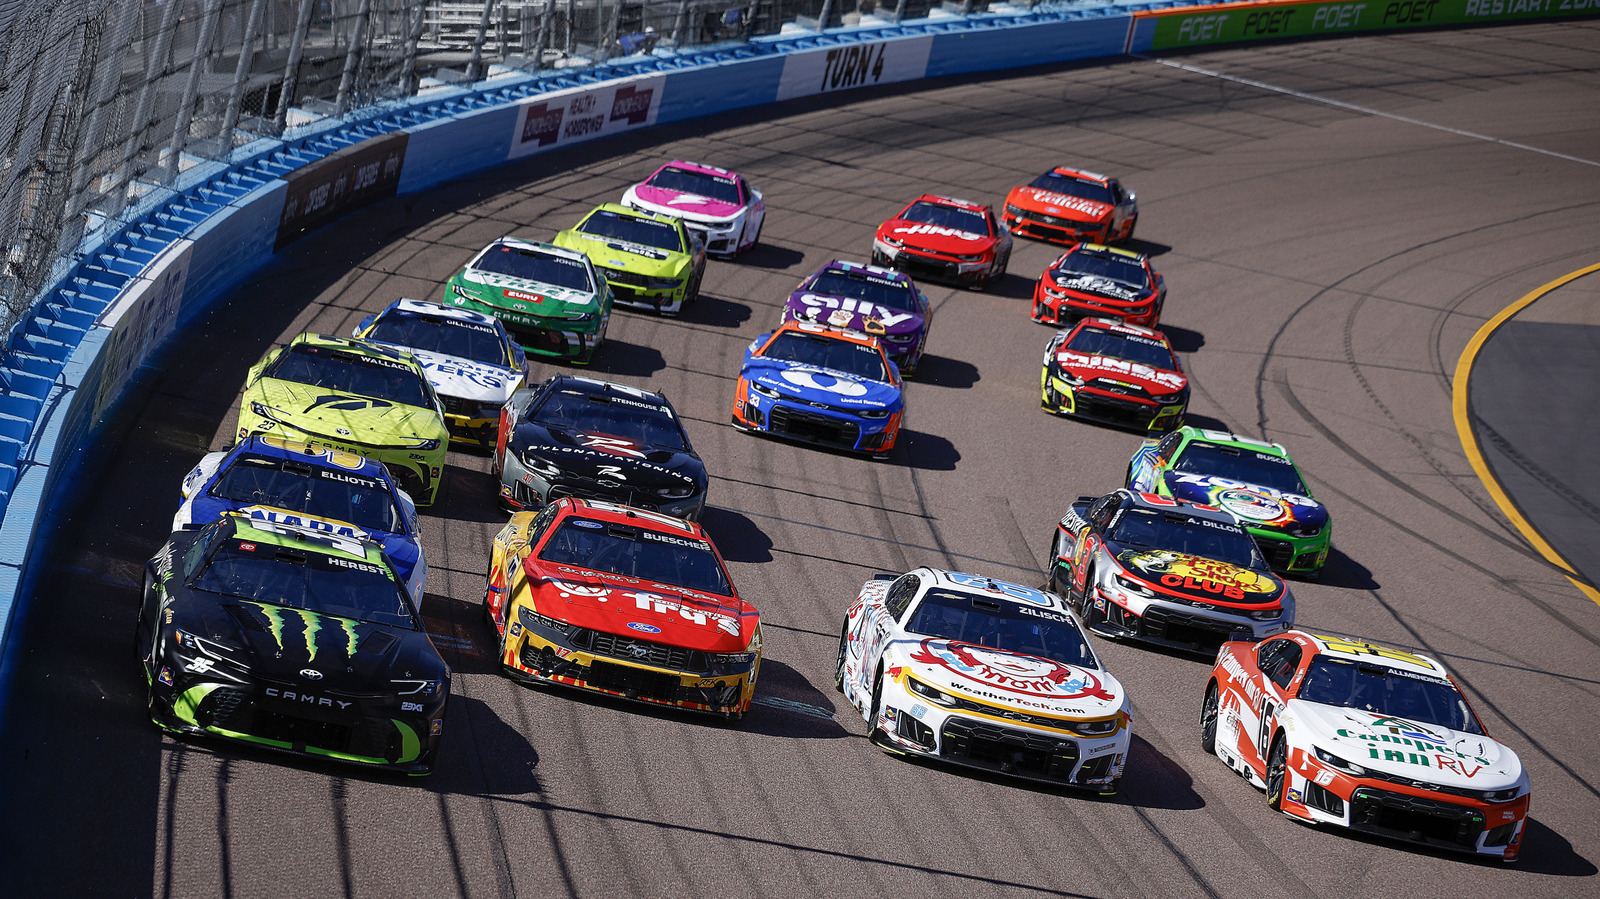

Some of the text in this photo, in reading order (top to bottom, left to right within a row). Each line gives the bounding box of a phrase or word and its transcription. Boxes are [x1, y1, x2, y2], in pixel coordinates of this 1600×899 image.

[1312, 4, 1367, 29] POET
[1383, 1, 1440, 24] POET
[1177, 15, 1229, 42] POET
[1243, 9, 1296, 35] POET
[821, 43, 886, 91] TURN 4
[553, 258, 583, 268] JONES
[866, 275, 903, 288] BOWMAN
[446, 319, 493, 334] GILLILAND
[493, 311, 542, 326] CAMRY
[856, 344, 878, 354] HILL
[360, 355, 412, 372] WALLACE
[1057, 352, 1186, 388] MINER
[611, 396, 658, 411] STENHOUSE
[749, 393, 761, 408] 33
[257, 420, 276, 430] 23
[310, 440, 372, 457] CAMRY
[1256, 452, 1291, 465] BUSCH
[320, 470, 376, 488] ELLIOTT
[522, 473, 535, 484] 47
[1187, 517, 1243, 535] A. DILLON
[643, 532, 711, 551] BUESCHER
[328, 557, 386, 575] HERBST
[1160, 574, 1246, 600] CLUB
[1117, 593, 1128, 606] 3
[1019, 606, 1073, 624] ZILISCH
[555, 646, 572, 657] 17
[1387, 667, 1451, 686] ALLMENDINGER
[265, 687, 353, 710] CAMRY
[950, 681, 1086, 715] WeatherTech.com
[909, 704, 928, 719] 88
[1336, 728, 1490, 778] campers inn RV
[1313, 768, 1337, 786] 16
